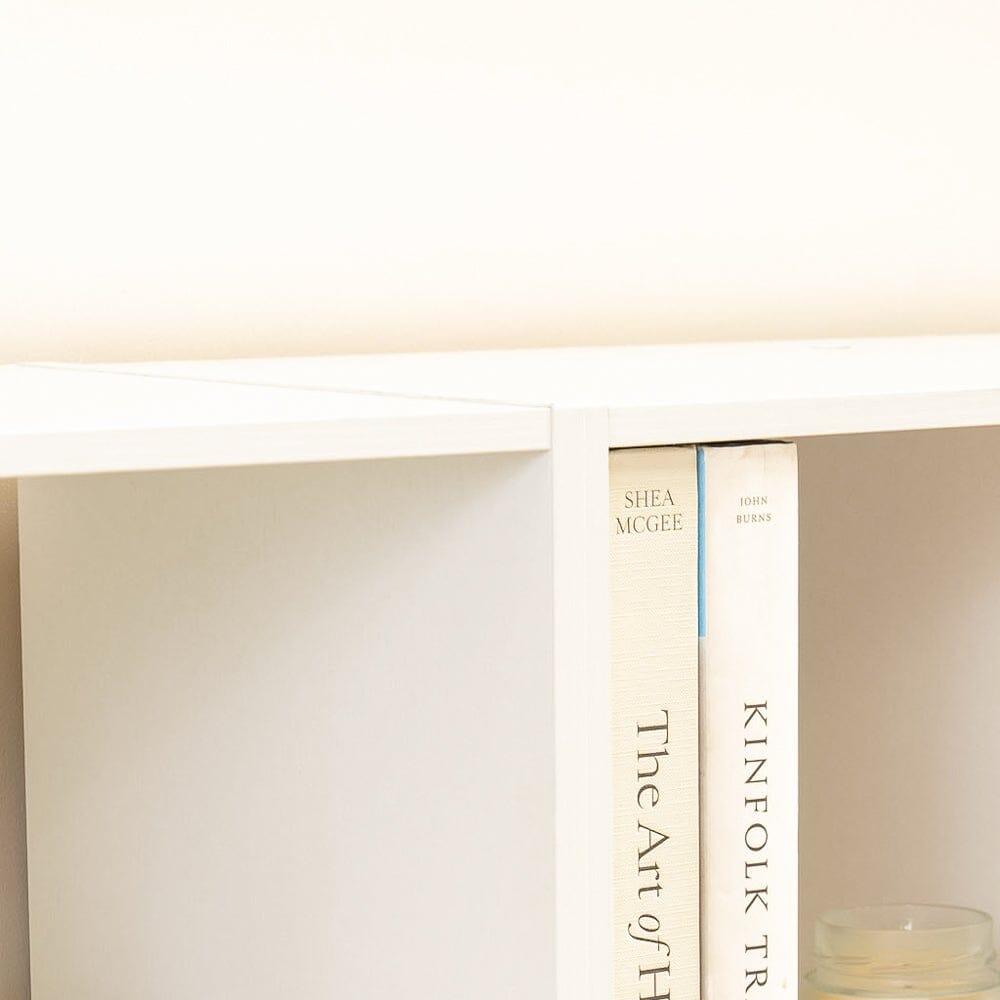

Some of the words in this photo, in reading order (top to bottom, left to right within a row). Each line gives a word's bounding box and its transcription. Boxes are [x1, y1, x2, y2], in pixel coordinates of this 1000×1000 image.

[624, 489, 675, 509] SHEA
[740, 496, 768, 507] JOHN
[615, 513, 683, 535] MCGEE
[736, 513, 772, 524] BURNS
[636, 709, 670, 810] The
[743, 700, 769, 915] KINFOLK
[637, 819, 670, 900] Art
[627, 913, 671, 957] of
